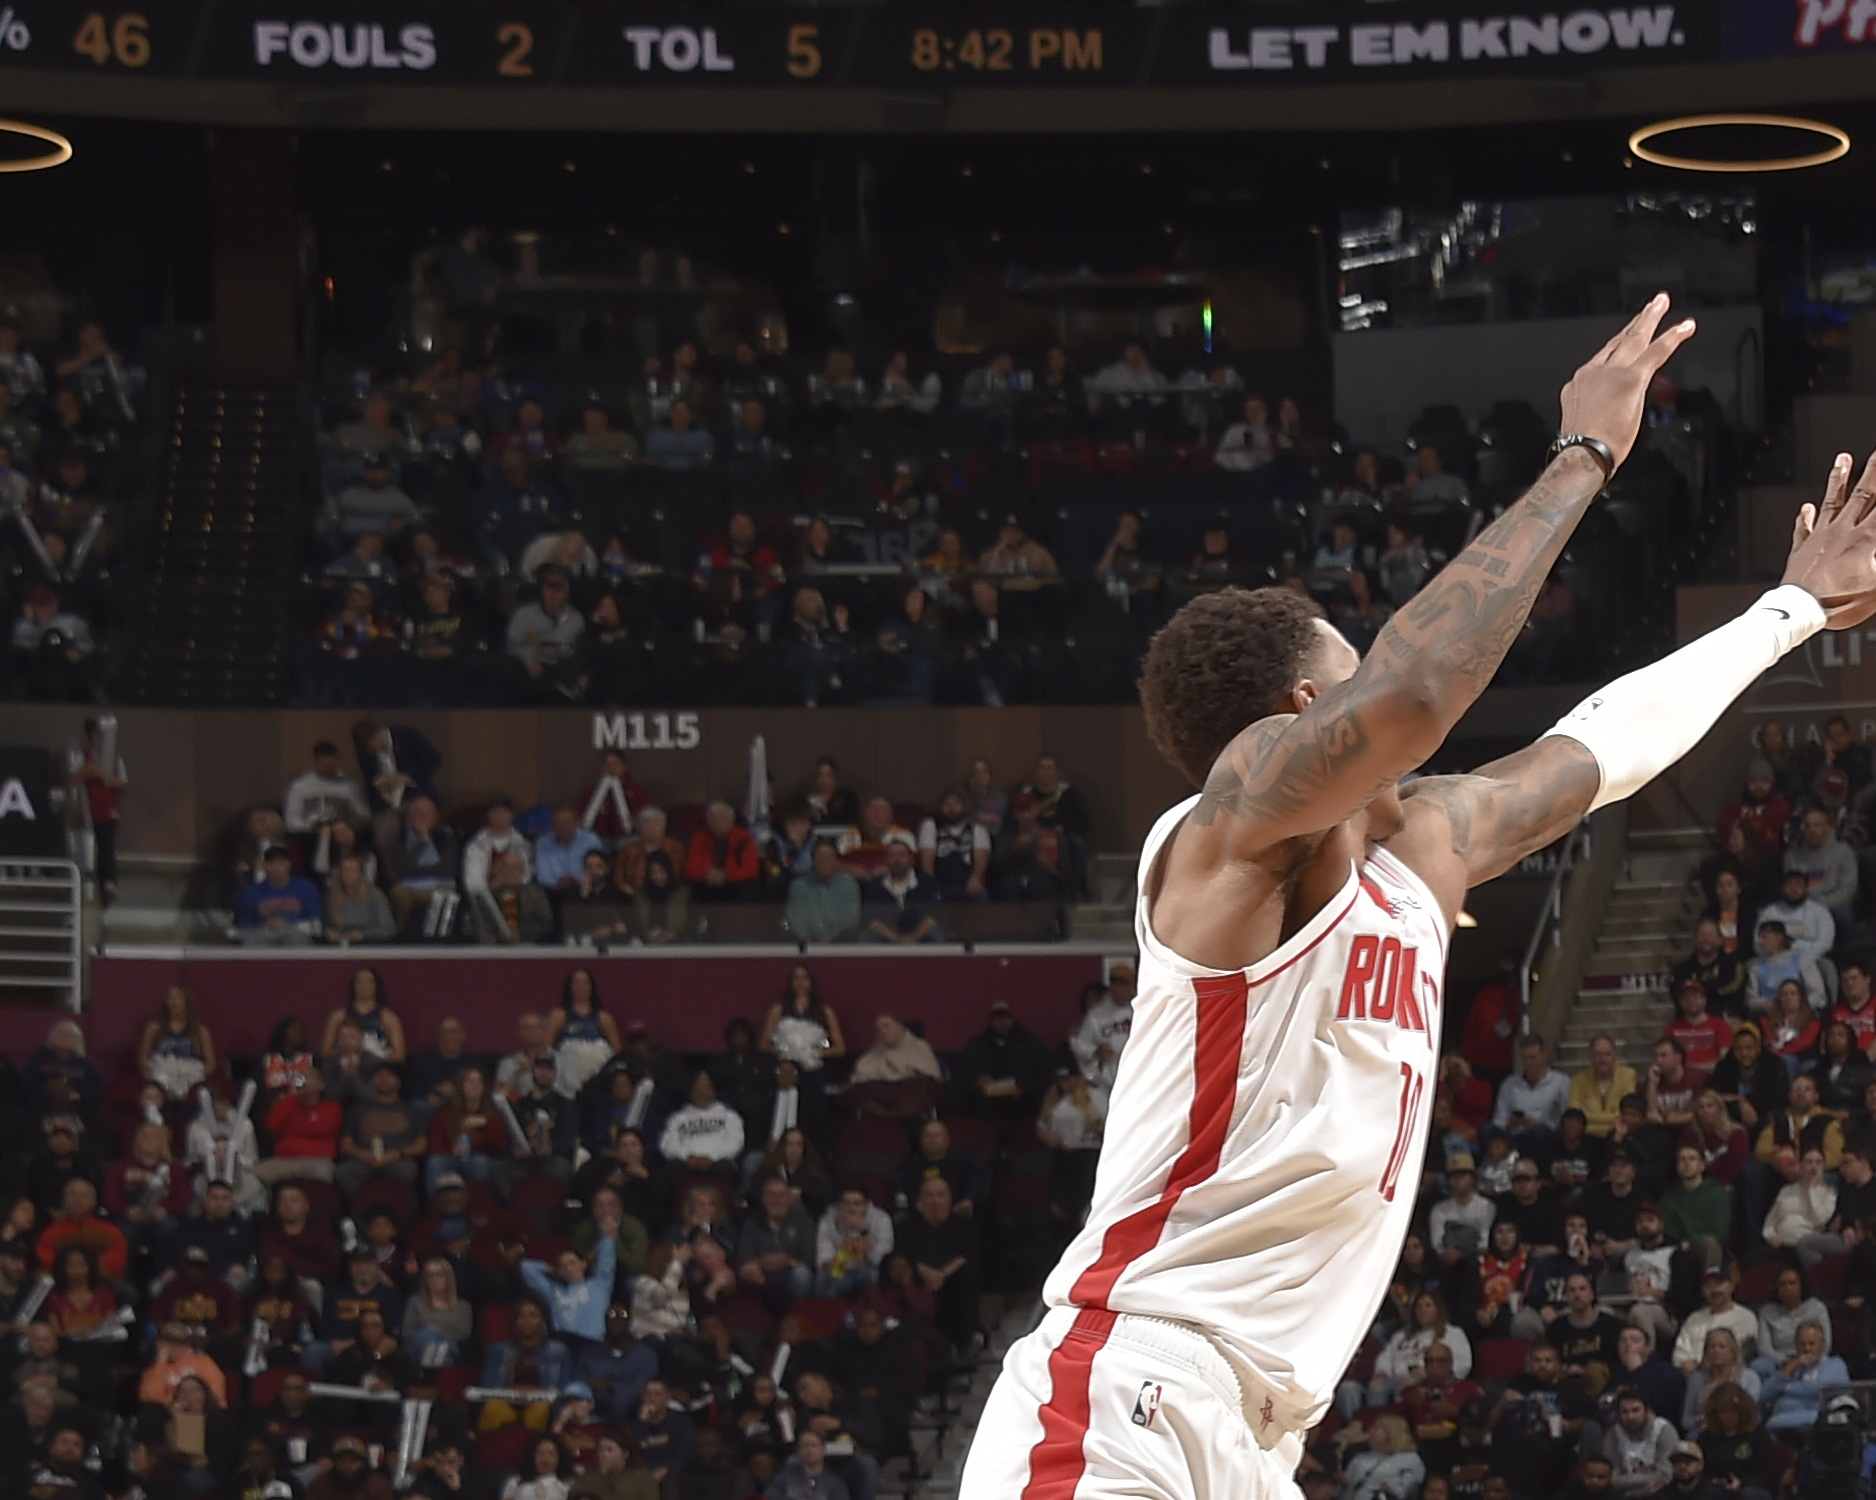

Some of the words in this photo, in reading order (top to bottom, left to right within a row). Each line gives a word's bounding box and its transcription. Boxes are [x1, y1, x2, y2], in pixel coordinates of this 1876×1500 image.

[73, 12, 151, 68] 46
[254, 20, 436, 70] FOULS
[497, 24, 535, 76] 2
[626, 26, 736, 72] TOL
[787, 25, 822, 78] 5
[911, 29, 1013, 70] 8:42
[1029, 29, 1103, 70] PM
[1208, 26, 1339, 70] LET
[1349, 19, 1450, 66] EM
[1459, 3, 1687, 60] KNOW.
[593, 710, 701, 750] M115
